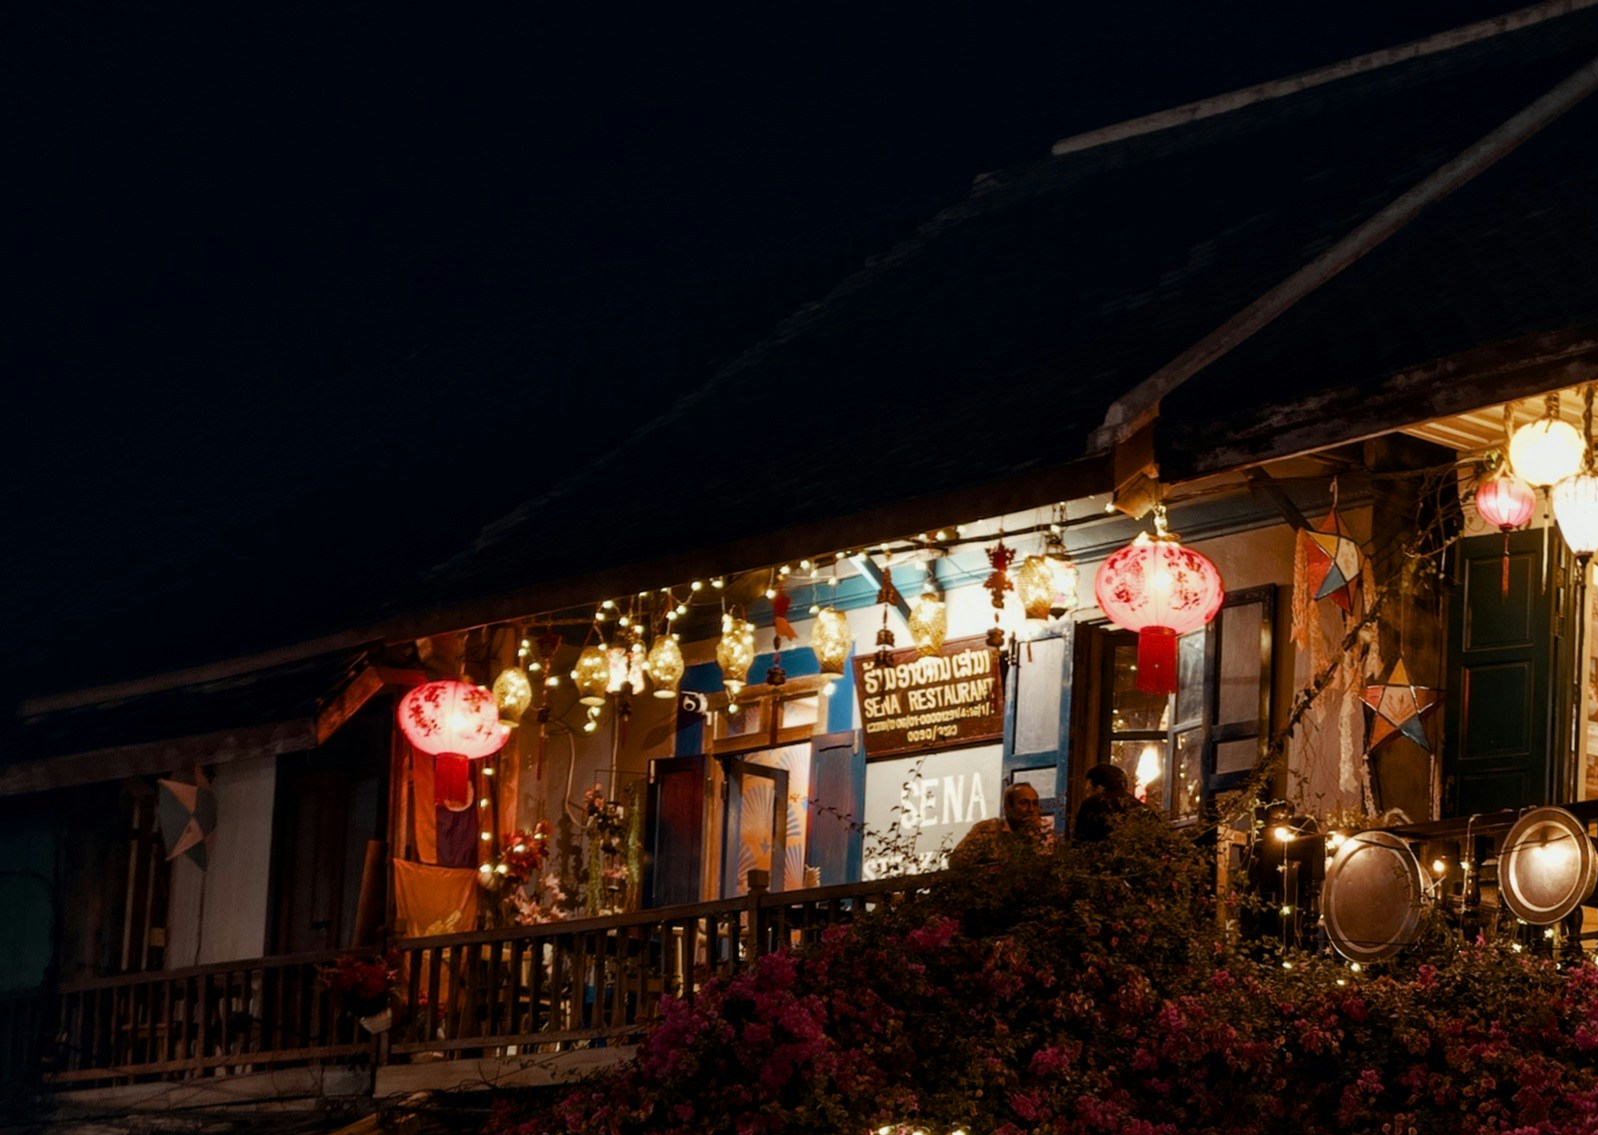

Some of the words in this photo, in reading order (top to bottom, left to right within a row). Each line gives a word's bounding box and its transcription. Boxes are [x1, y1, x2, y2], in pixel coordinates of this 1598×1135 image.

[864, 694, 902, 718] SENA
[907, 677, 996, 711] RESTAURANT
[900, 772, 988, 830] SENA
